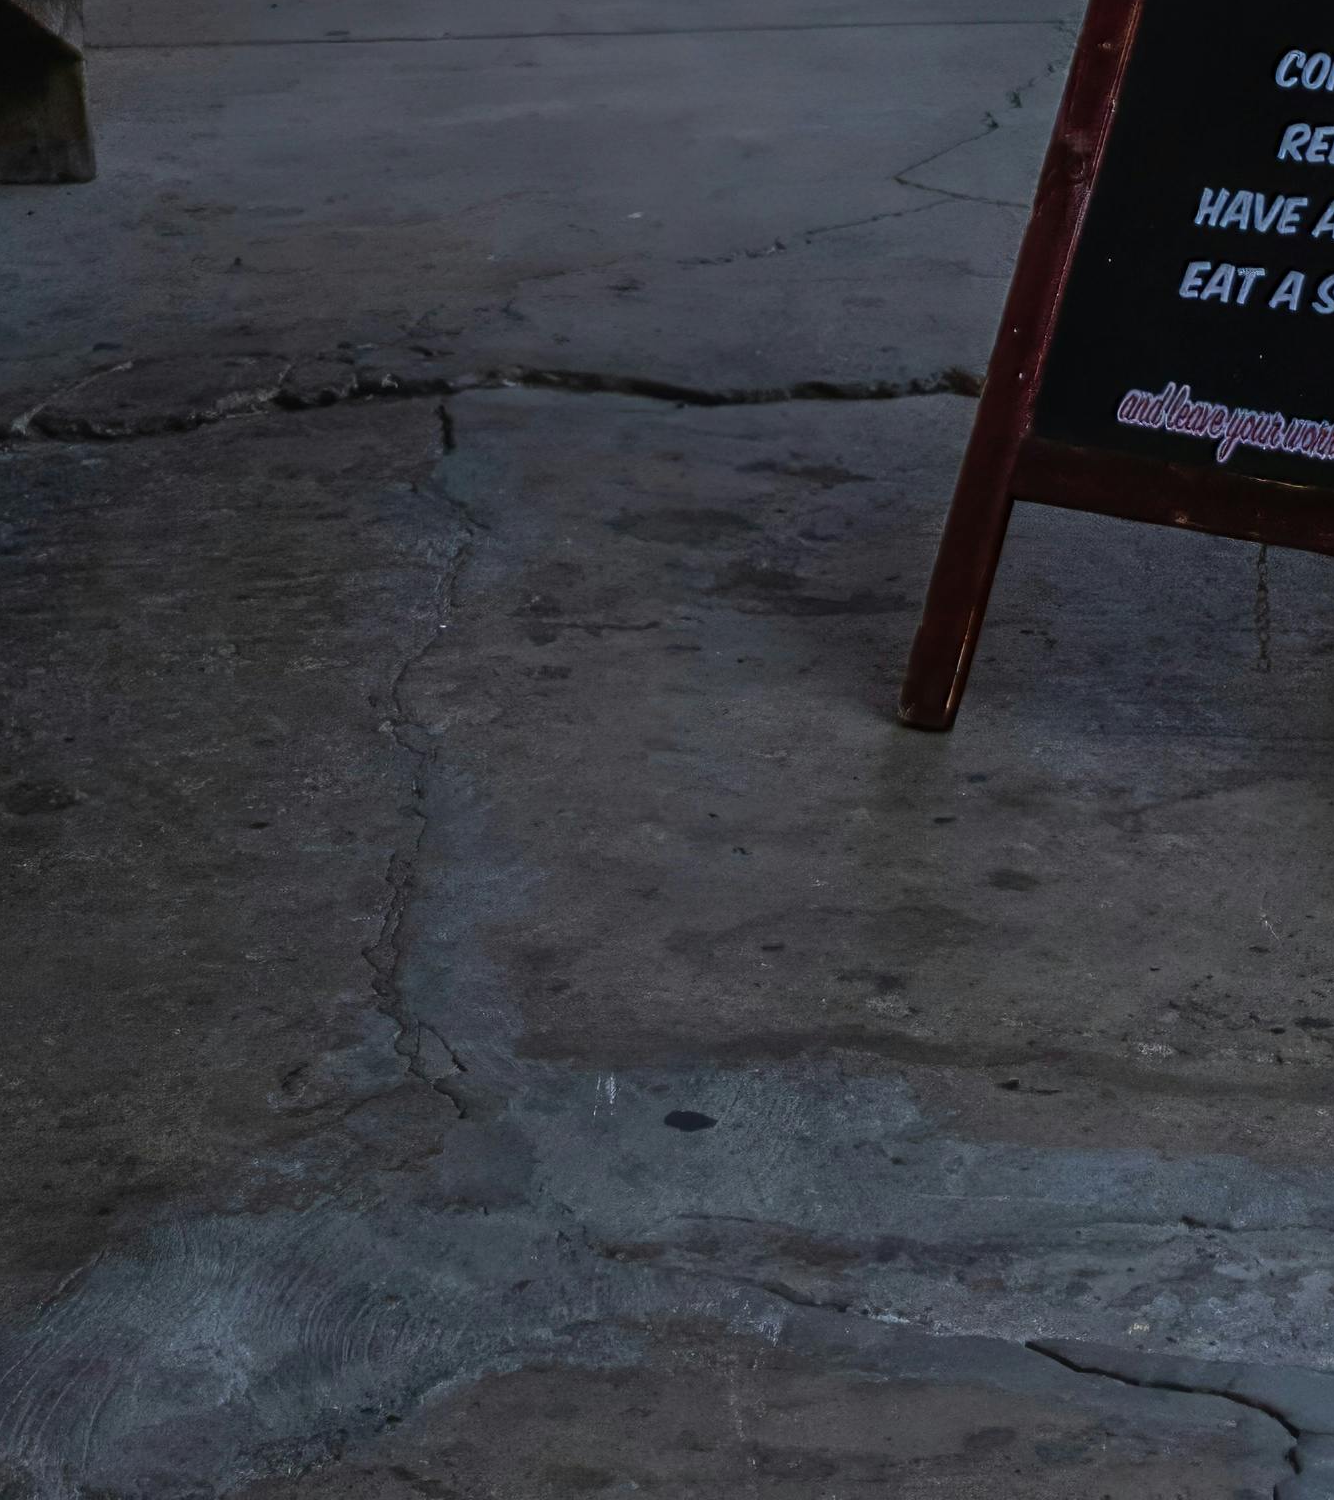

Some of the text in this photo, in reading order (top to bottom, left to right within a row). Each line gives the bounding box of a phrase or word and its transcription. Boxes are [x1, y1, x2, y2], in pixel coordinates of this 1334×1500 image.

[1194, 187, 1308, 237] HAVE
[1179, 261, 1266, 304] EAT
[1269, 272, 1305, 311] A
[1117, 381, 1173, 428] and
[1166, 385, 1227, 437] leave
[1217, 407, 1285, 463] your
